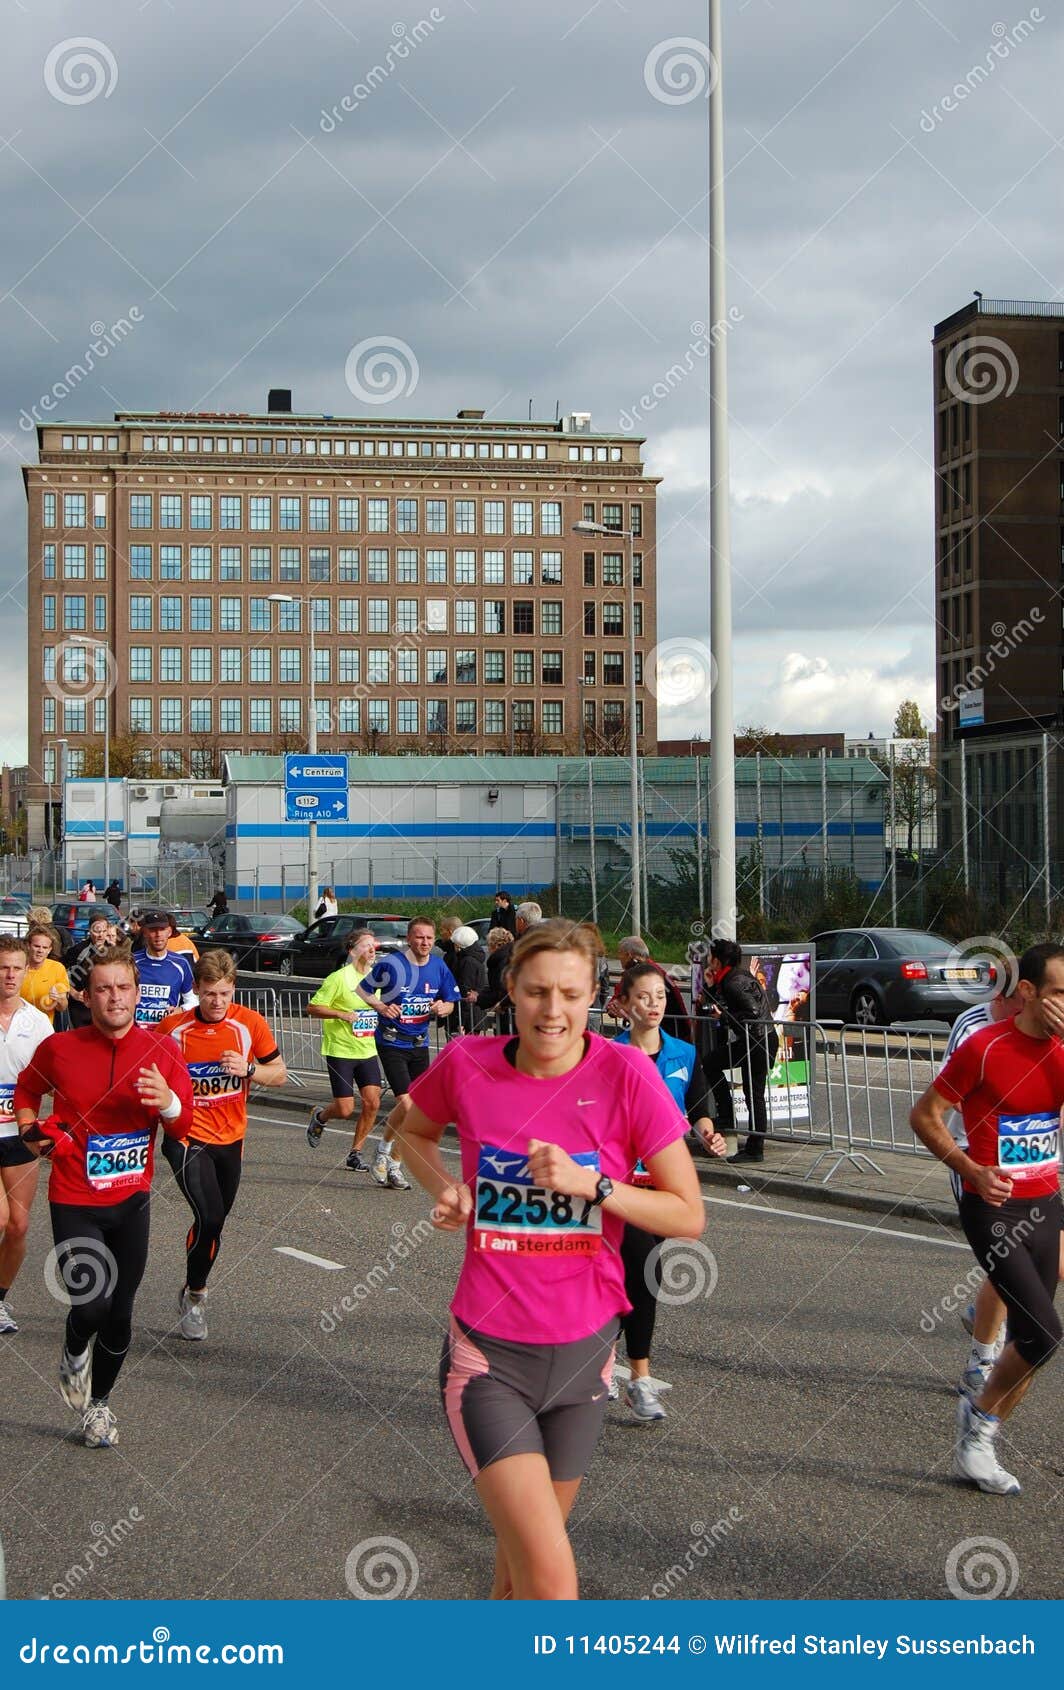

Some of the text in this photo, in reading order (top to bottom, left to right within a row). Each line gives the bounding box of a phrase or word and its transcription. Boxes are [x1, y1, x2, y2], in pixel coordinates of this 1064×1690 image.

[295, 811, 313, 819] Ring
[141, 986, 167, 995] BERT
[192, 1075, 240, 1096] 20870
[1001, 1132, 1057, 1162] 23620
[90, 1147, 148, 1174] 23686
[480, 1232, 487, 1249] I
